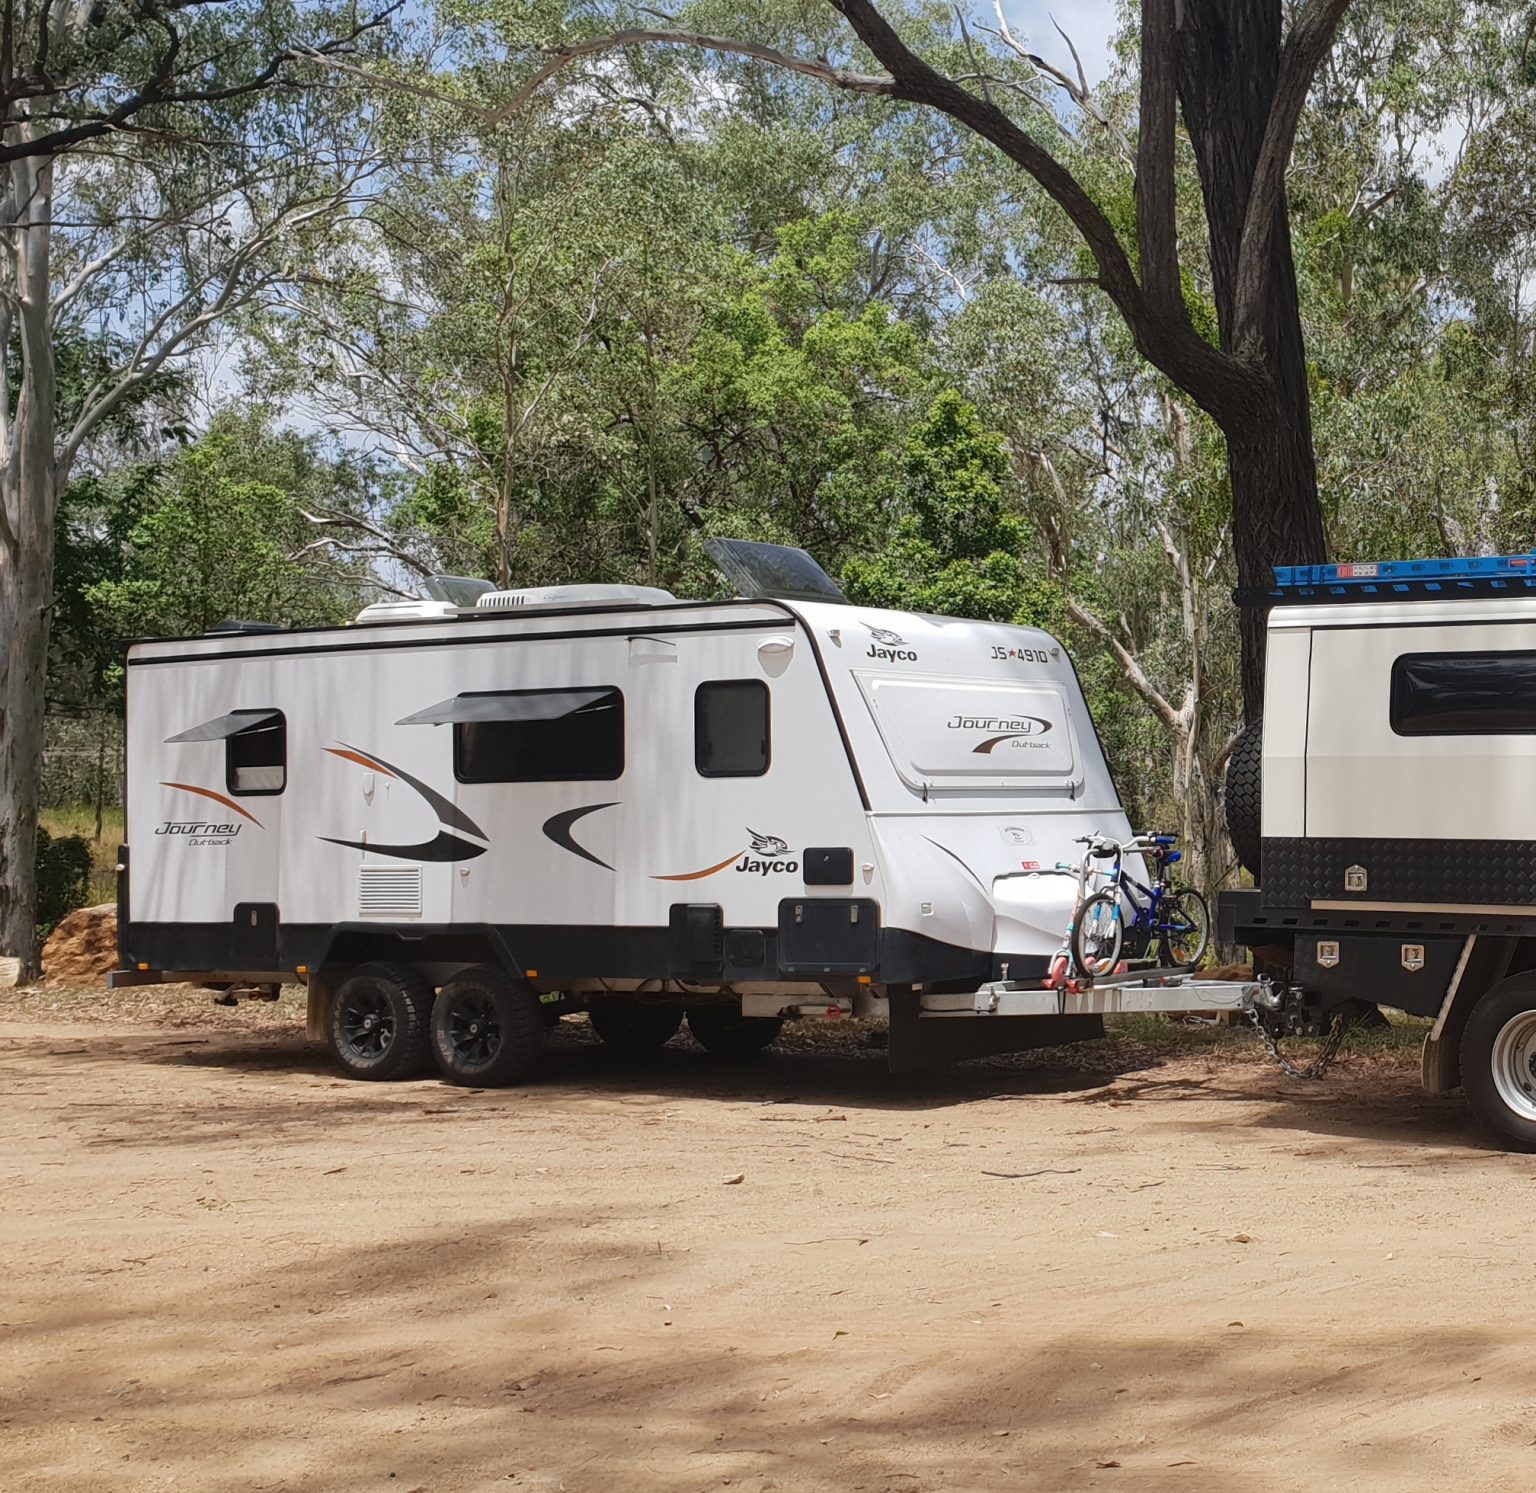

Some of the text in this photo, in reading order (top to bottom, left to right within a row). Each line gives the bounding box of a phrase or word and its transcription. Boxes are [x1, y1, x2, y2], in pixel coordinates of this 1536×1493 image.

[866, 644, 917, 662] Jayco
[947, 715, 1031, 733] Journey
[1011, 740, 1053, 749] Outback
[155, 821, 242, 838] Journey
[188, 838, 232, 847] Outback
[736, 856, 799, 877] Jayco
